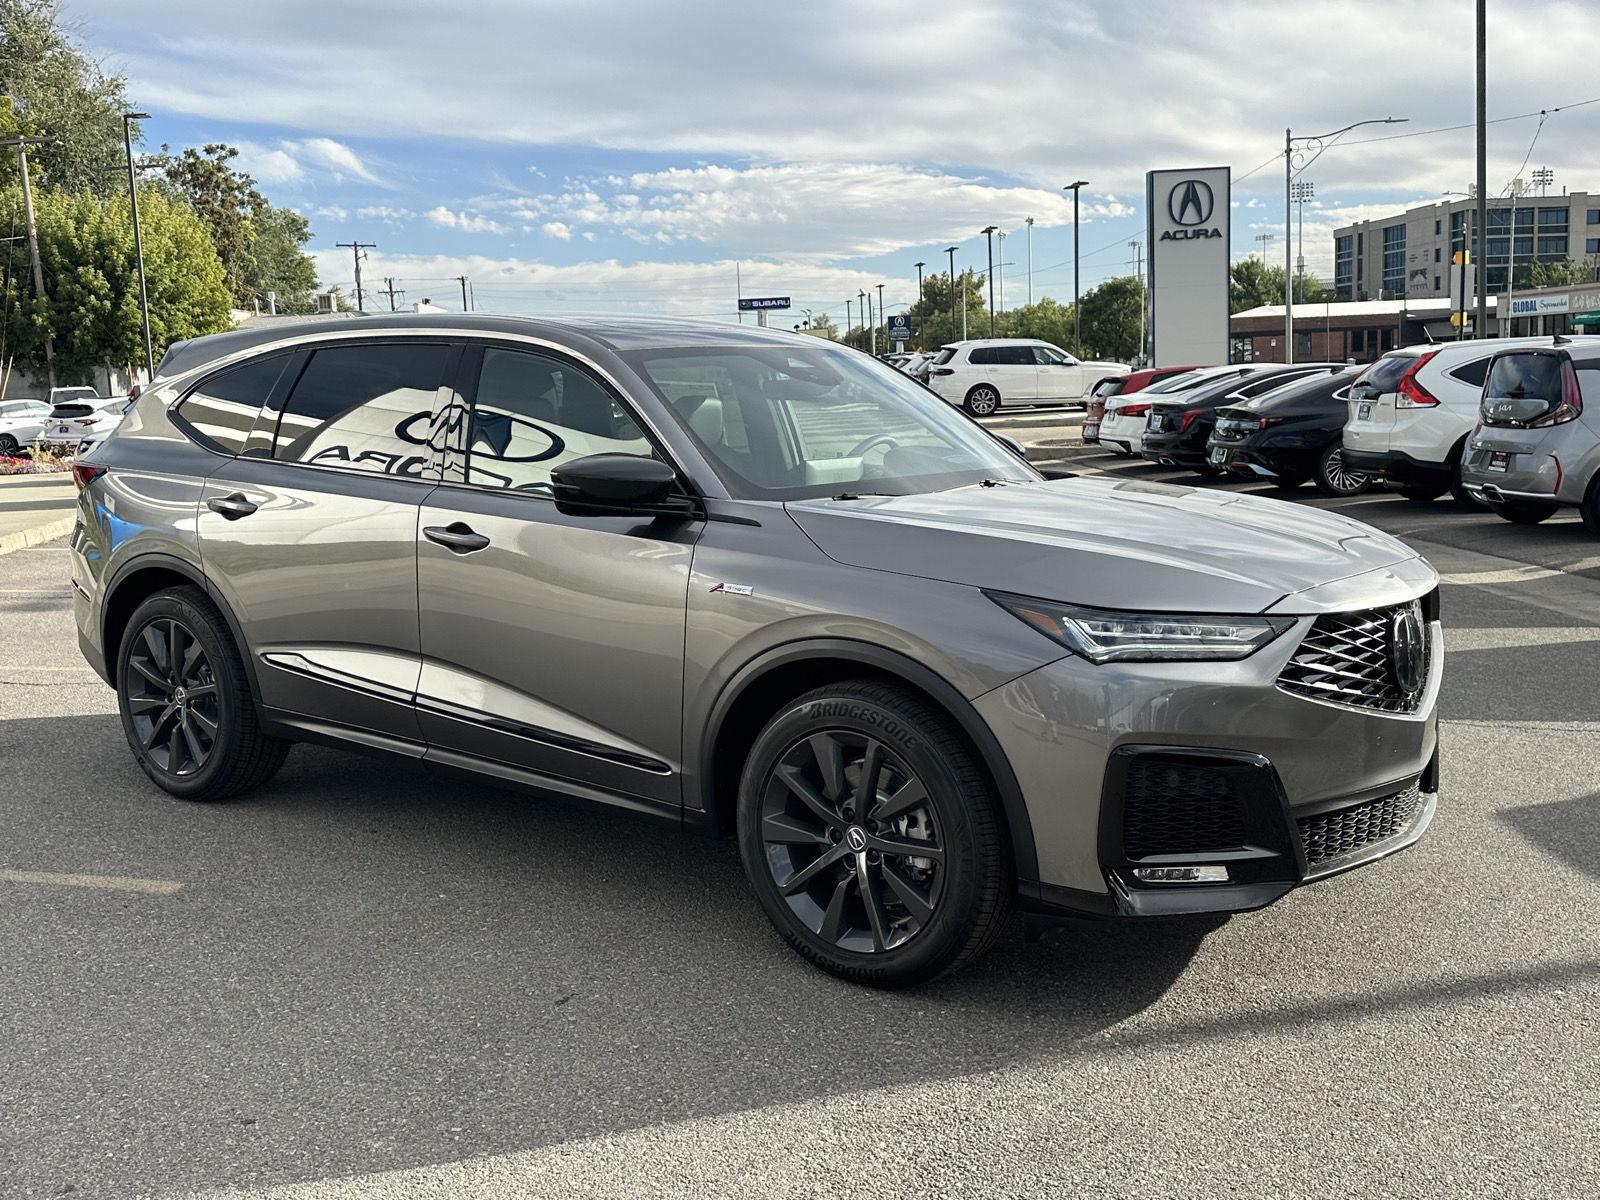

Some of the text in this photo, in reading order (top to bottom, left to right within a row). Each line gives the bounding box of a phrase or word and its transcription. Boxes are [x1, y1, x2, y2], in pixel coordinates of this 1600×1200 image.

[1160, 228, 1222, 241] ACURA
[1512, 300, 1538, 313] GLOBAL
[810, 702, 917, 749] BRIDGESTONE
